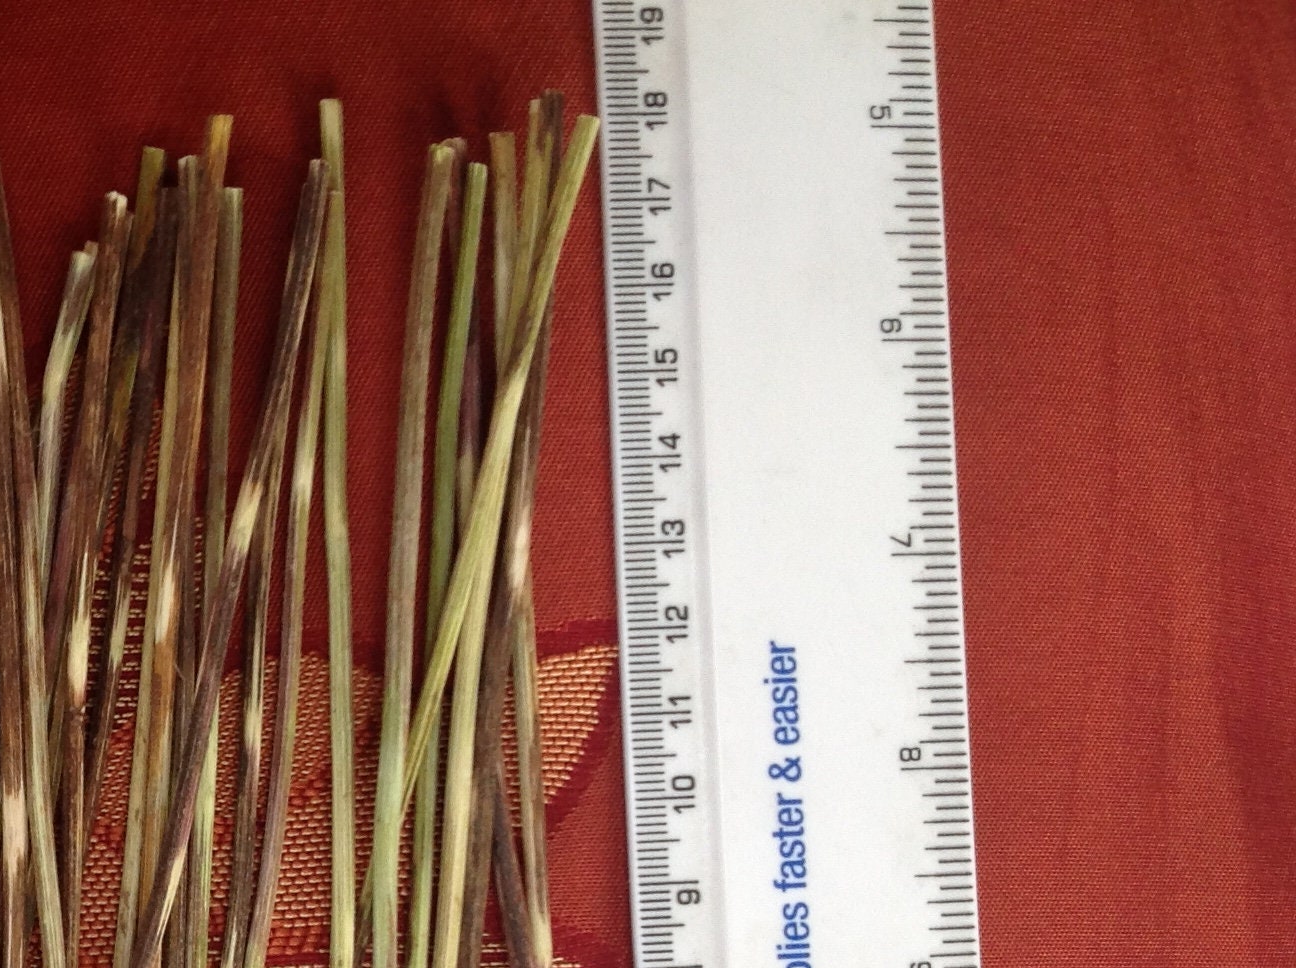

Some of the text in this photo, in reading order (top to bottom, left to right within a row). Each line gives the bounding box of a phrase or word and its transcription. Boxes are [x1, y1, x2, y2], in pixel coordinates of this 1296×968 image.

[640, 7, 664, 45] 19
[644, 91, 668, 130] 18
[869, 104, 892, 120] 5
[647, 177, 671, 216] 17
[651, 262, 675, 301] 16
[880, 318, 903, 333] 6
[654, 348, 679, 387] 15
[659, 433, 681, 472] 14
[662, 519, 685, 558] 13
[889, 532, 912, 547] 7
[665, 605, 689, 643] 12
[669, 696, 691, 729] 11
[765, 641, 800, 747] easier
[767, 756, 802, 784] &
[900, 747, 921, 762] 8
[672, 775, 695, 814] 10
[772, 794, 807, 893] faster
[677, 888, 701, 905] 9
